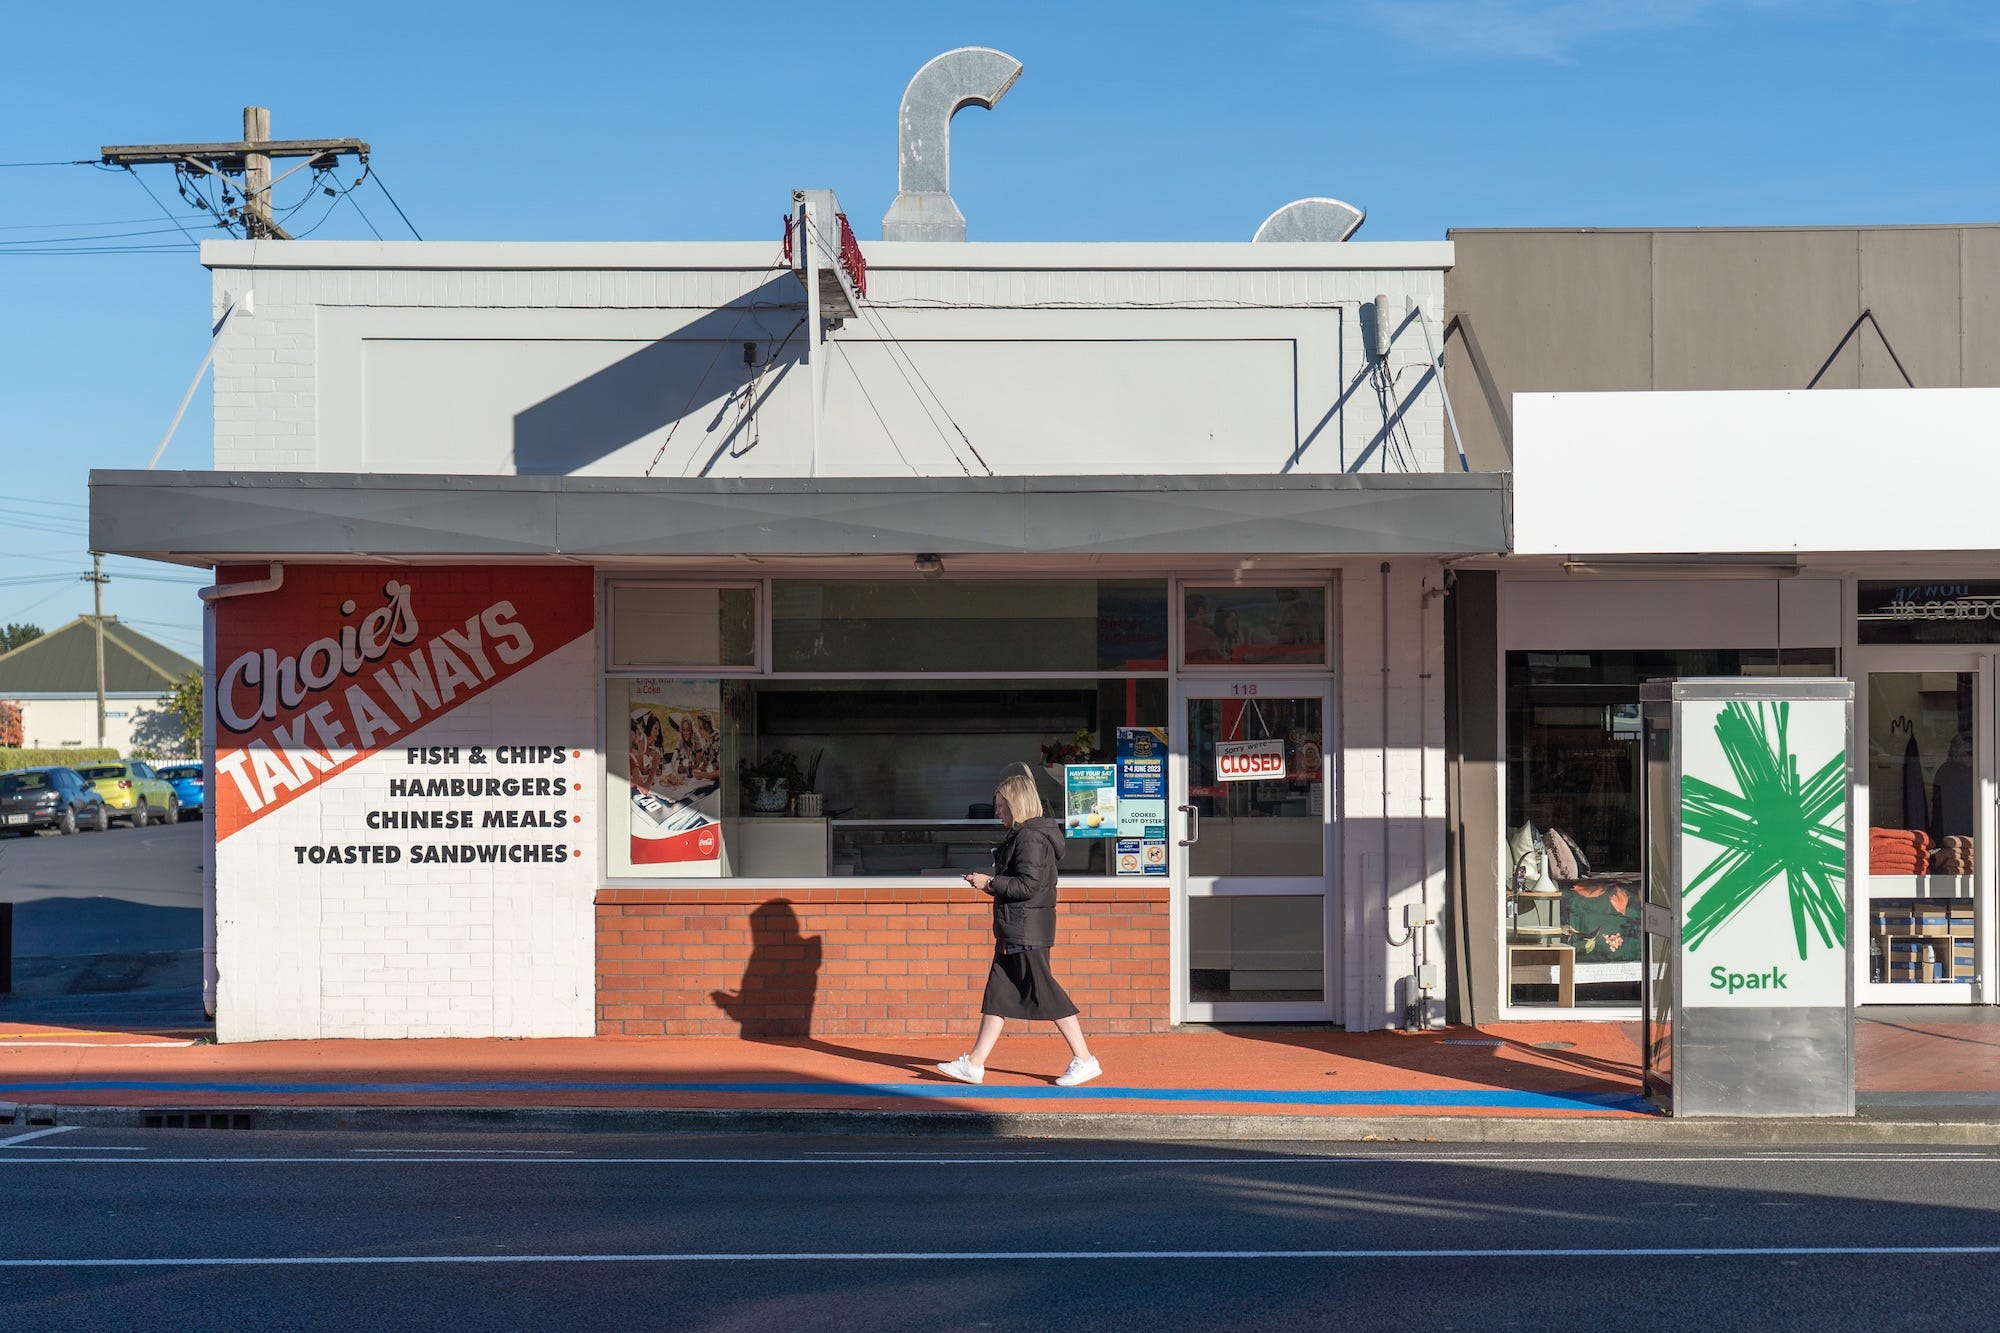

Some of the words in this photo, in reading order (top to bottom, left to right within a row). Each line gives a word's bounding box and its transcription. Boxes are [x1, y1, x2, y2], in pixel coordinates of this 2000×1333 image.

[217, 580, 419, 733] Choie's
[1233, 684, 1257, 695] 118
[215, 600, 535, 814] TAKEAWAYS
[407, 746, 459, 764] FISH
[469, 746, 487, 764] &
[496, 745, 566, 764] CHIPS
[1225, 746, 1244, 754] Sorry
[1221, 753, 1282, 774] CLOSED
[389, 778, 567, 797] HAMBURGERS
[366, 811, 473, 829] CHINESE
[481, 810, 567, 828] MEALS
[294, 846, 400, 864] TOASTED
[410, 844, 567, 863] SANDWICHES
[1710, 966, 1788, 994] Spark
